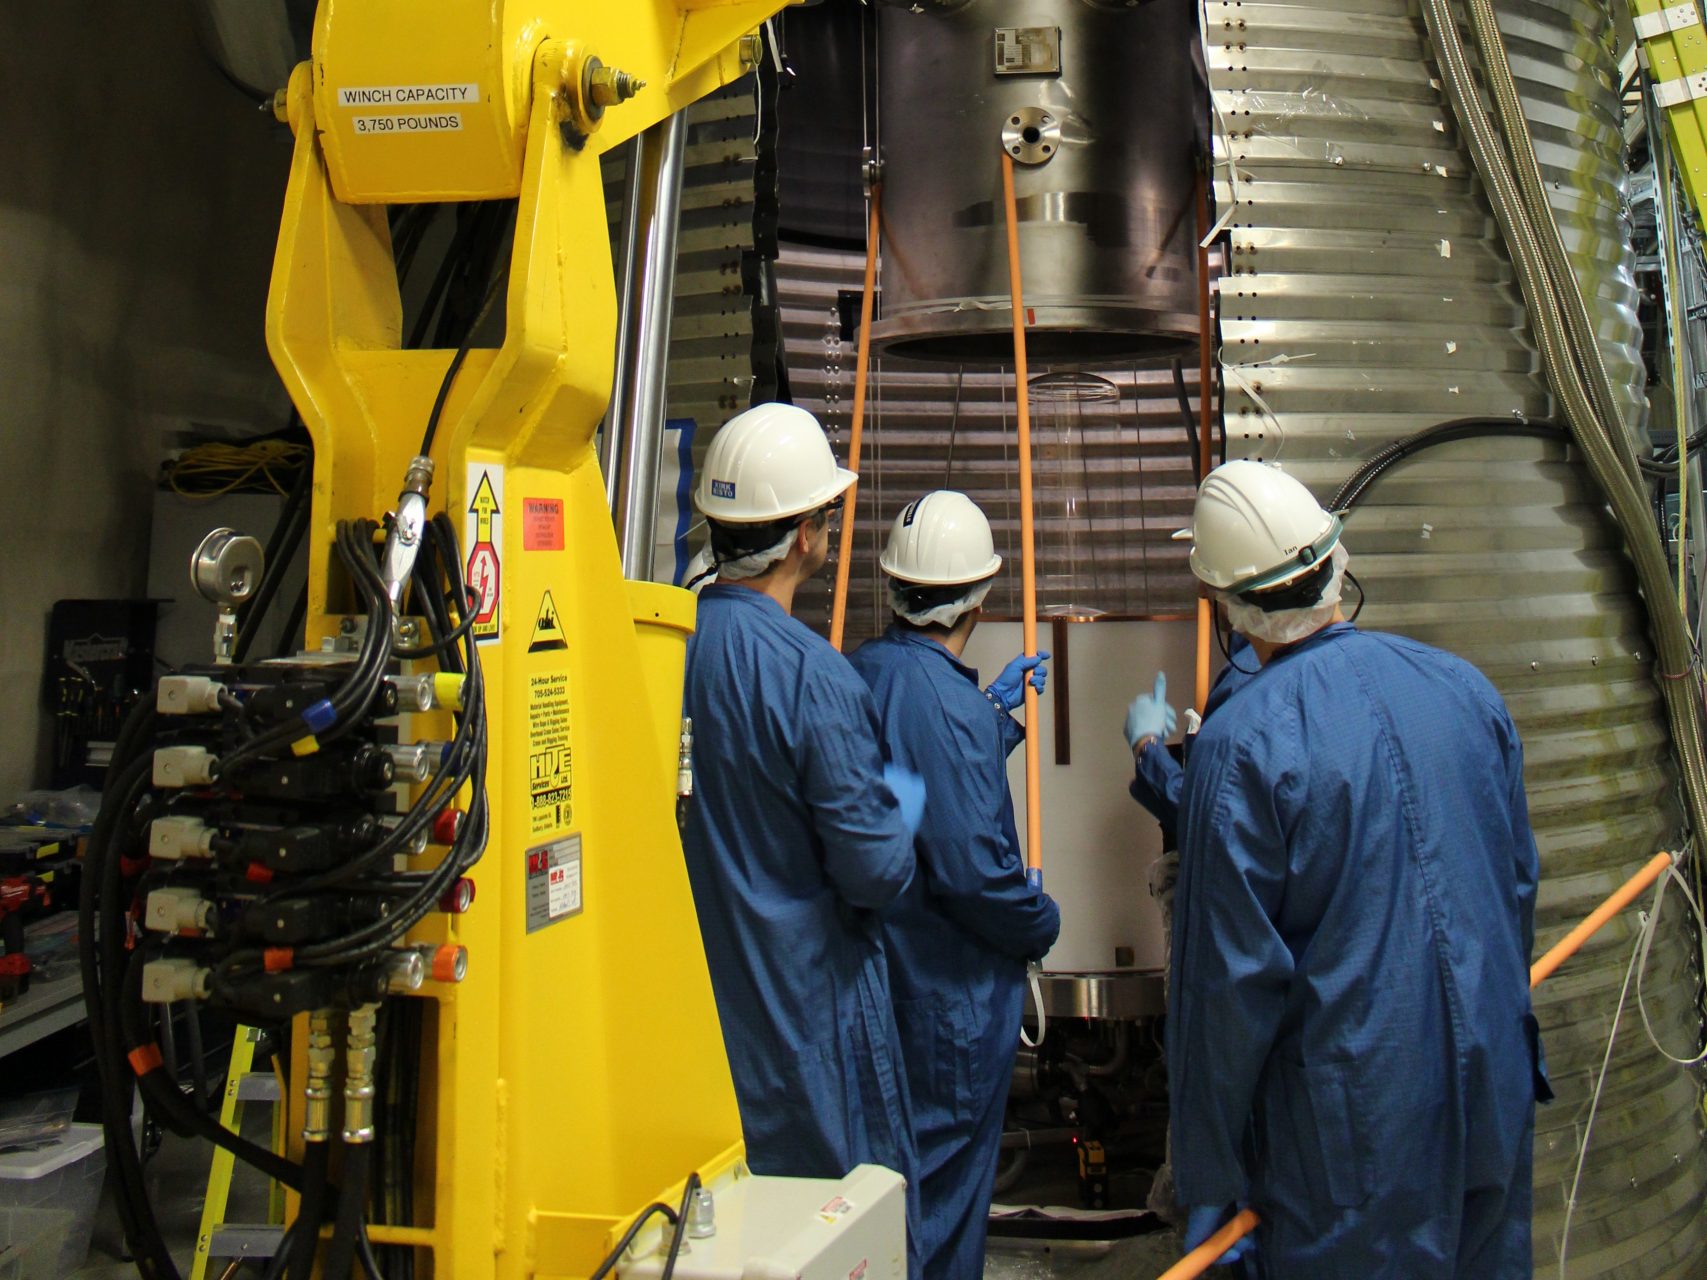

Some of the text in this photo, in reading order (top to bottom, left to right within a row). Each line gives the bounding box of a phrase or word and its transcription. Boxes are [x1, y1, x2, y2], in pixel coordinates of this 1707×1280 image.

[344, 87, 468, 103] WINCH CAPACITY
[357, 116, 459, 133] 3,750 POUNDS
[528, 503, 559, 514] WARNING
[1284, 545, 1298, 556] Ian
[531, 674, 567, 686] 24-Hour Service
[530, 744, 572, 782] HITE
